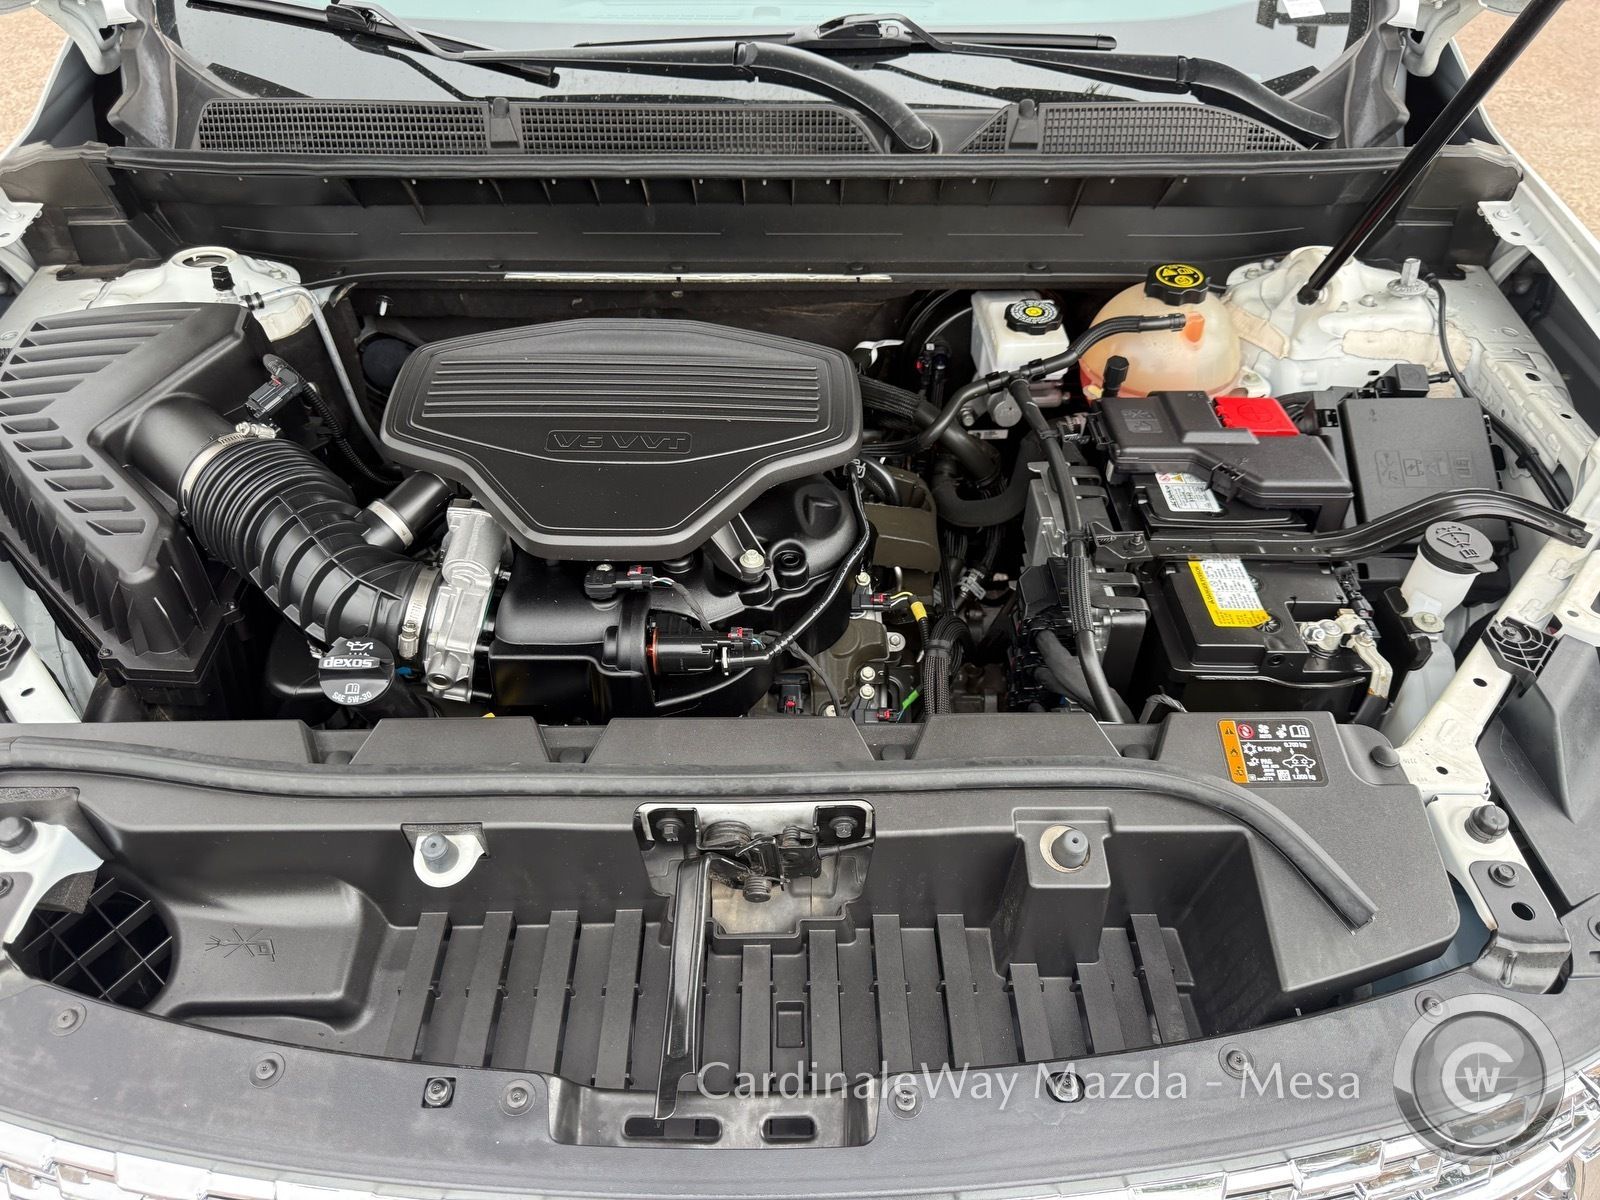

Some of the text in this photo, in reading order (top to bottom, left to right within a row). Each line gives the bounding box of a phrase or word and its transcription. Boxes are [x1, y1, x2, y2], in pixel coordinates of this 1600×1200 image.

[553, 434, 686, 450] V6 VVT
[323, 657, 375, 668] dexos
[332, 691, 372, 703] SAE 5W-30
